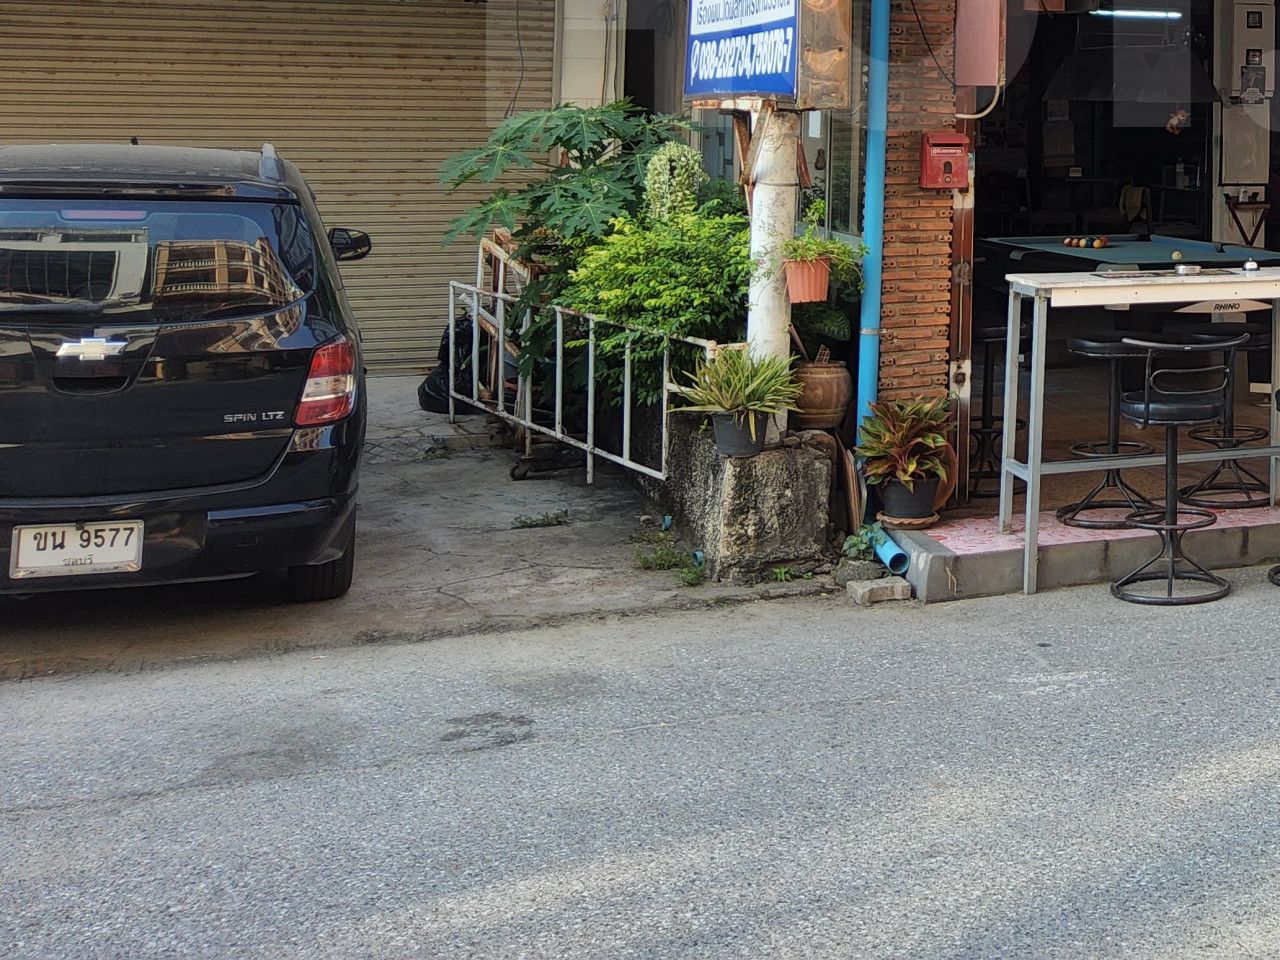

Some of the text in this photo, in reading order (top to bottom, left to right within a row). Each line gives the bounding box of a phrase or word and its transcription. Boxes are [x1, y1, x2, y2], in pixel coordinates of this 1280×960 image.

[1213, 302, 1241, 311] RHINO
[223, 410, 285, 423] SPIN LTZ
[33, 526, 135, 552] ขน 9577
